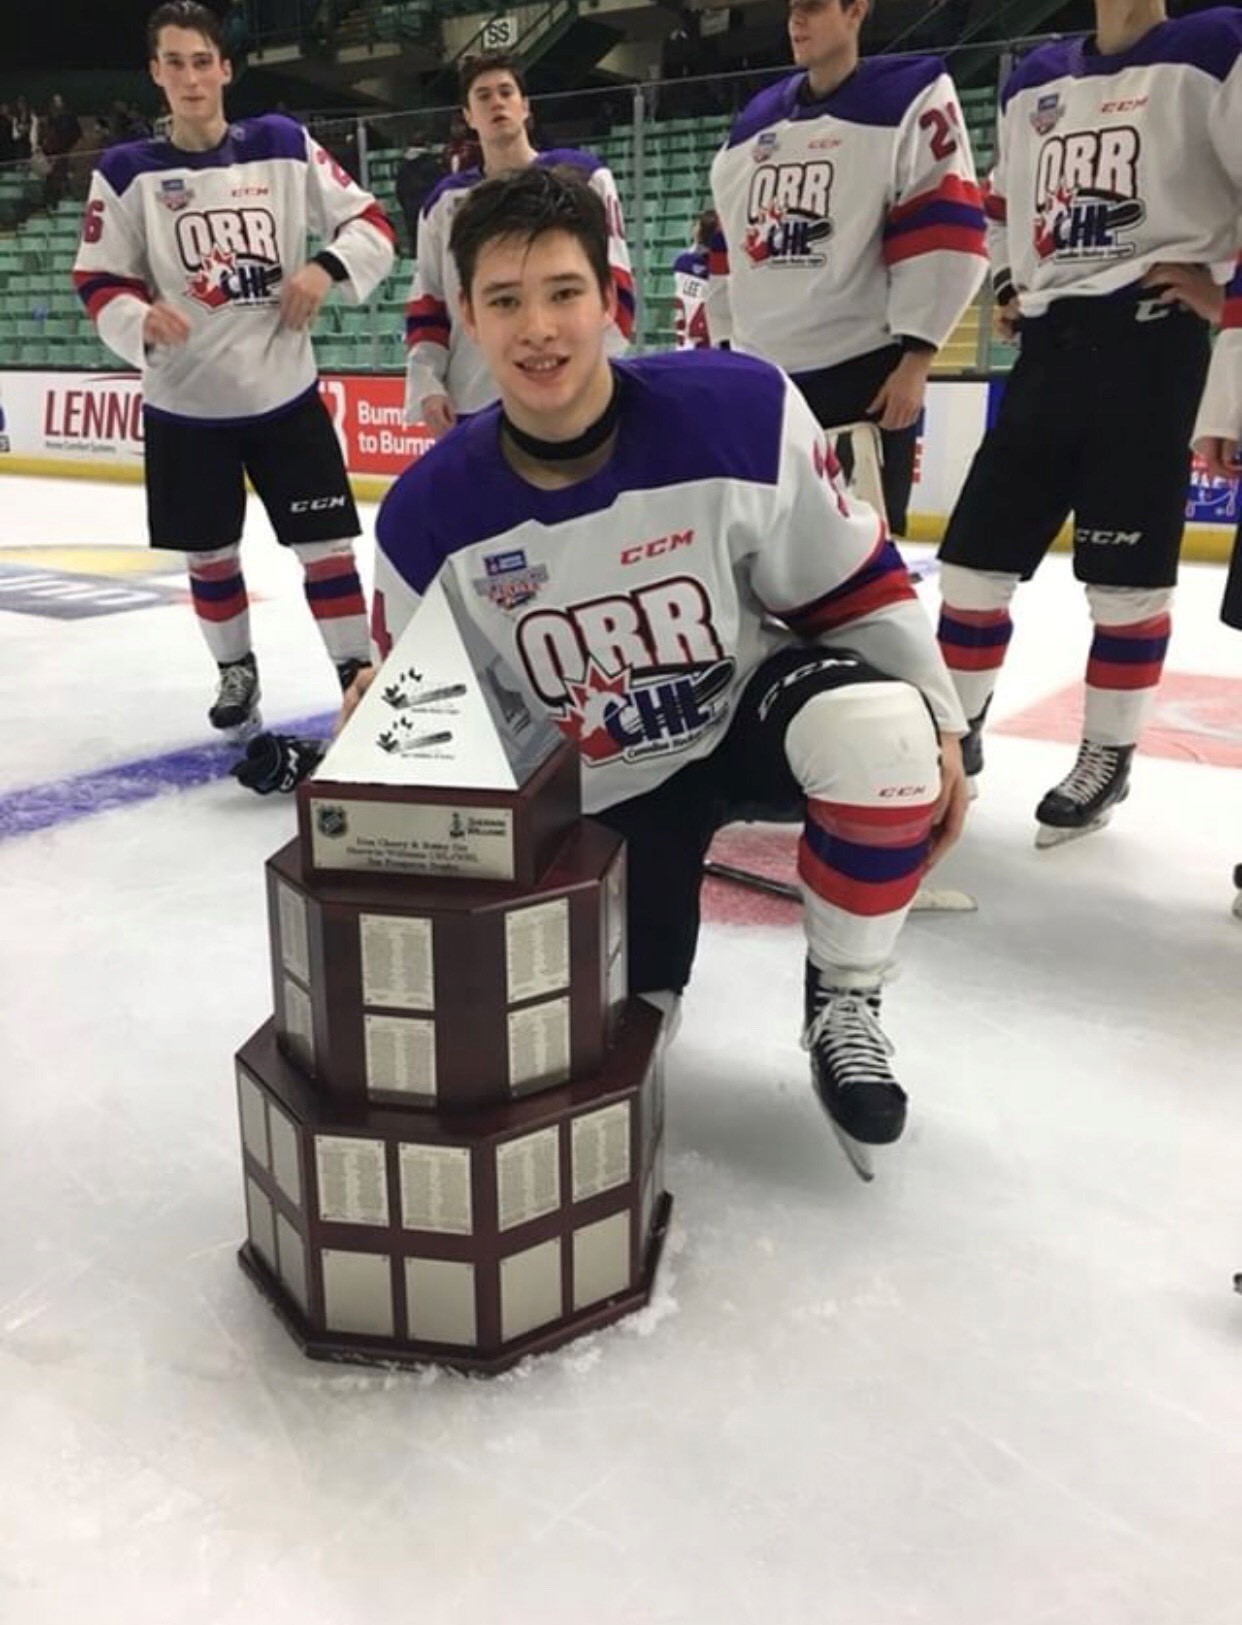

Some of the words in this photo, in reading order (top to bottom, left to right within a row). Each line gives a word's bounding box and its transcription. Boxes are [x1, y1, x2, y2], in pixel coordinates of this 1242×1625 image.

[488, 23, 510, 46] SS
[747, 160, 834, 224] ORR
[1035, 125, 1141, 213] ORR
[175, 207, 279, 272] ORR
[44, 388, 145, 442] LENNO
[358, 432, 377, 454] to
[290, 495, 345, 513] CCM
[620, 531, 695, 565] CCM
[515, 575, 727, 708] ORR
[603, 679, 711, 748] CHL
